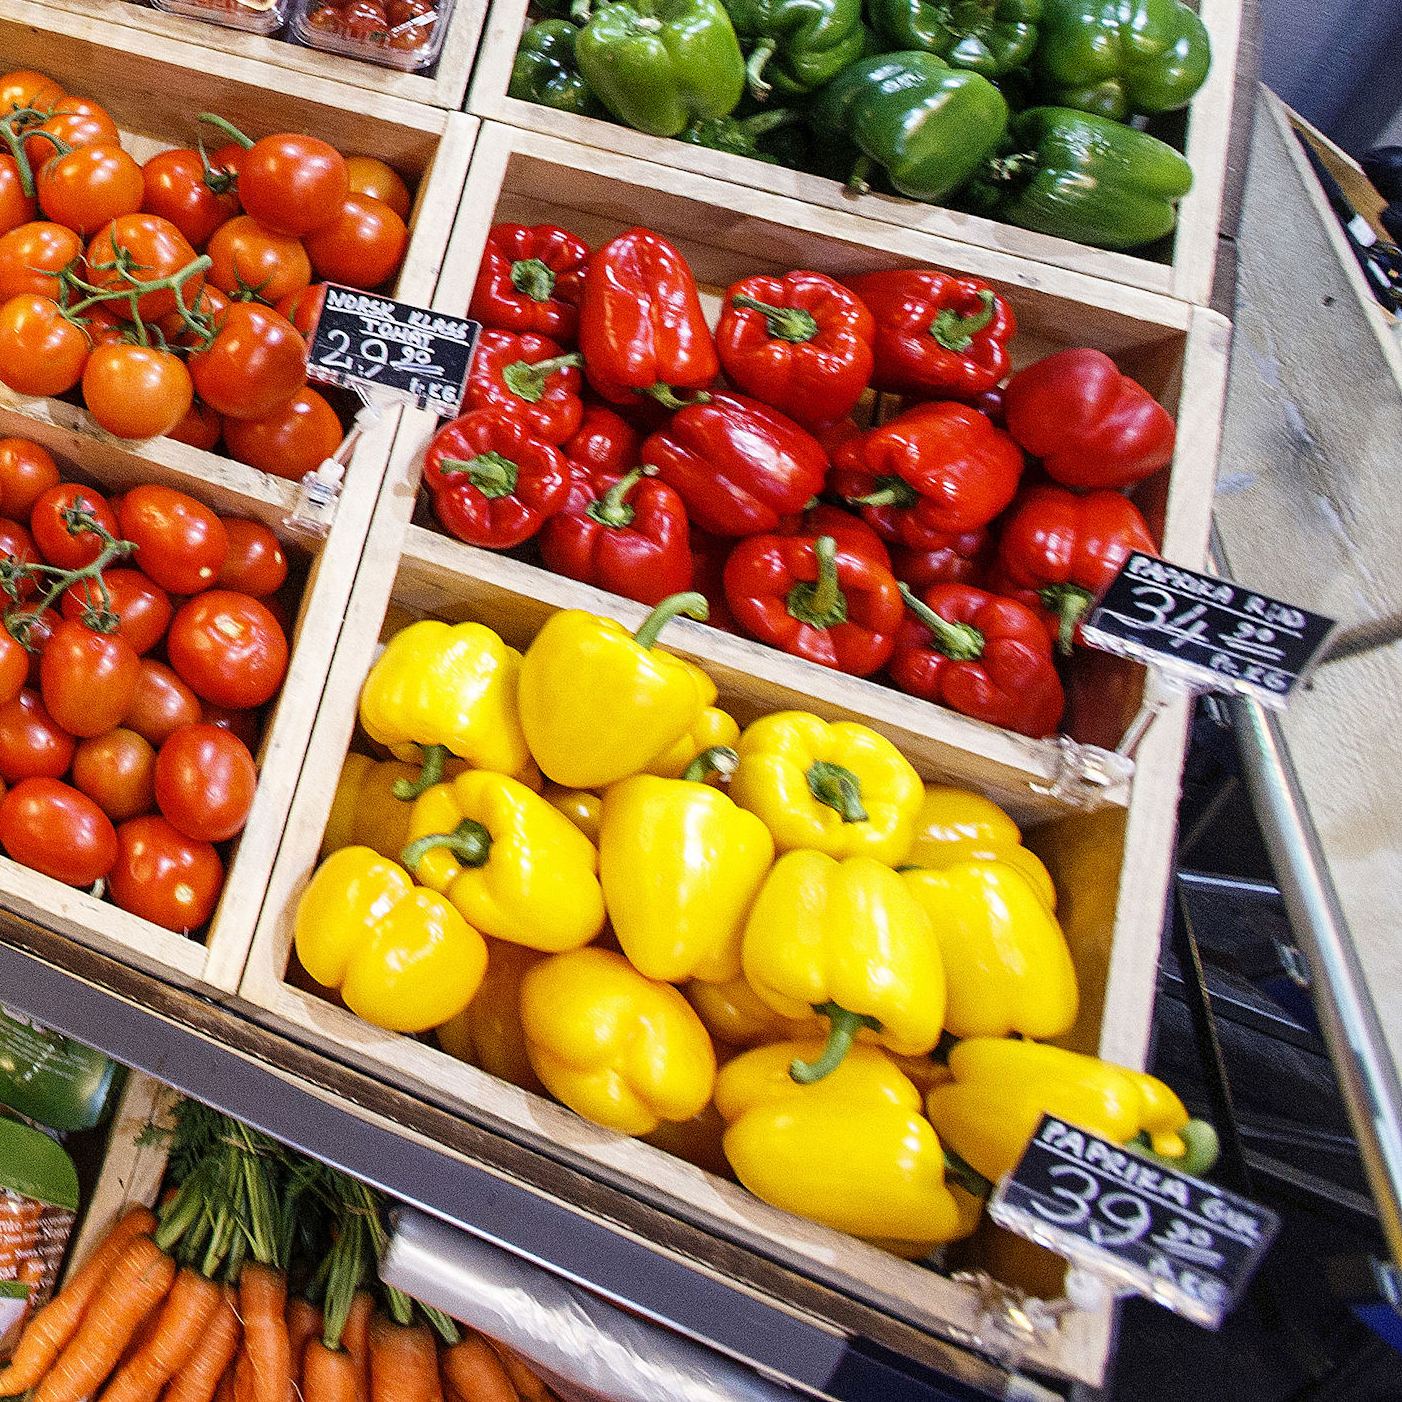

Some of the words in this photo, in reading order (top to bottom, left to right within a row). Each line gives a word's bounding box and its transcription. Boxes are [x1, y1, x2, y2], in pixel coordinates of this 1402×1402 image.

[326, 289, 396, 321] NORSK
[360, 316, 435, 349] TOMAT
[319, 329, 389, 379] 29
[1120, 585, 1210, 648] 34
[1041, 1120, 1191, 1207] PAPRIKA
[1030, 1163, 1153, 1247] 39
